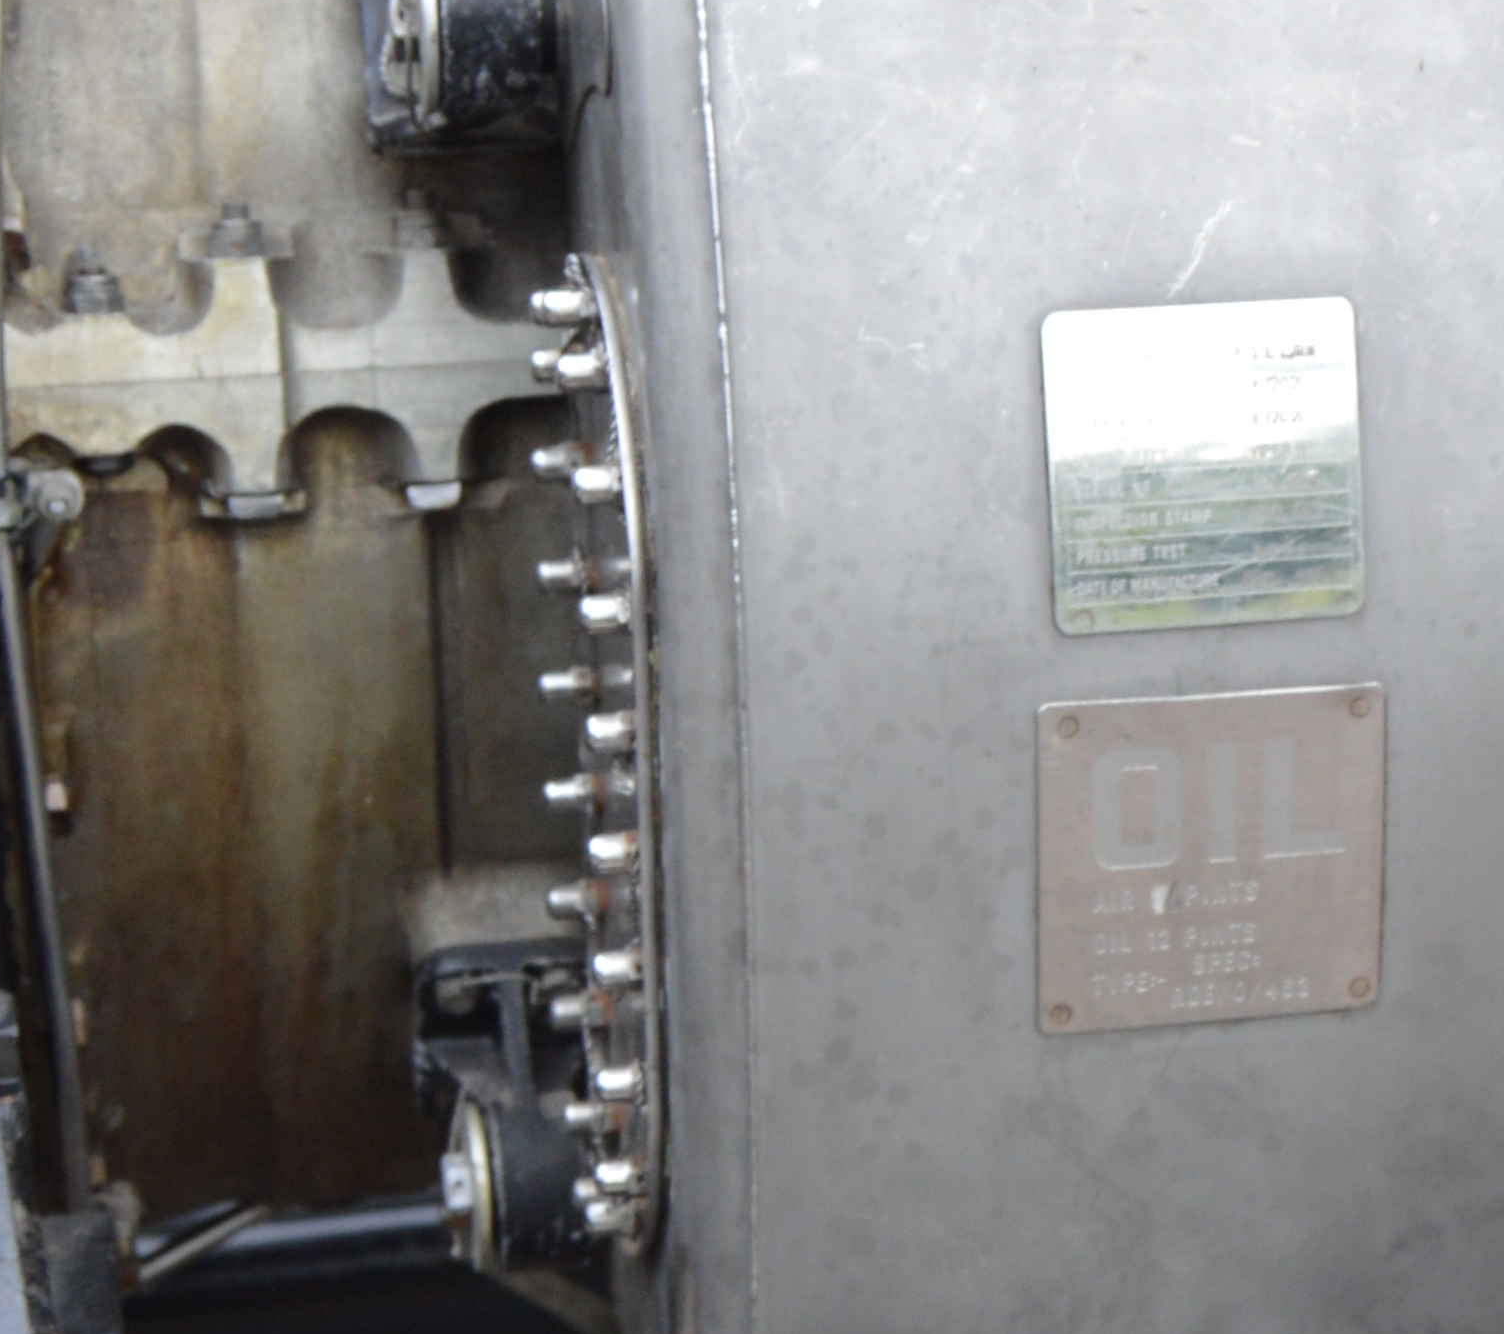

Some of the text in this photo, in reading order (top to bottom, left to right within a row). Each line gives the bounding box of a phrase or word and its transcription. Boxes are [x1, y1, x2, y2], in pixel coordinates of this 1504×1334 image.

[1091, 736, 1347, 871] OIL
[1092, 889, 1135, 914] AIR
[1185, 880, 1261, 908] PINTS
[1093, 922, 1257, 957] OIL 12 PINTS
